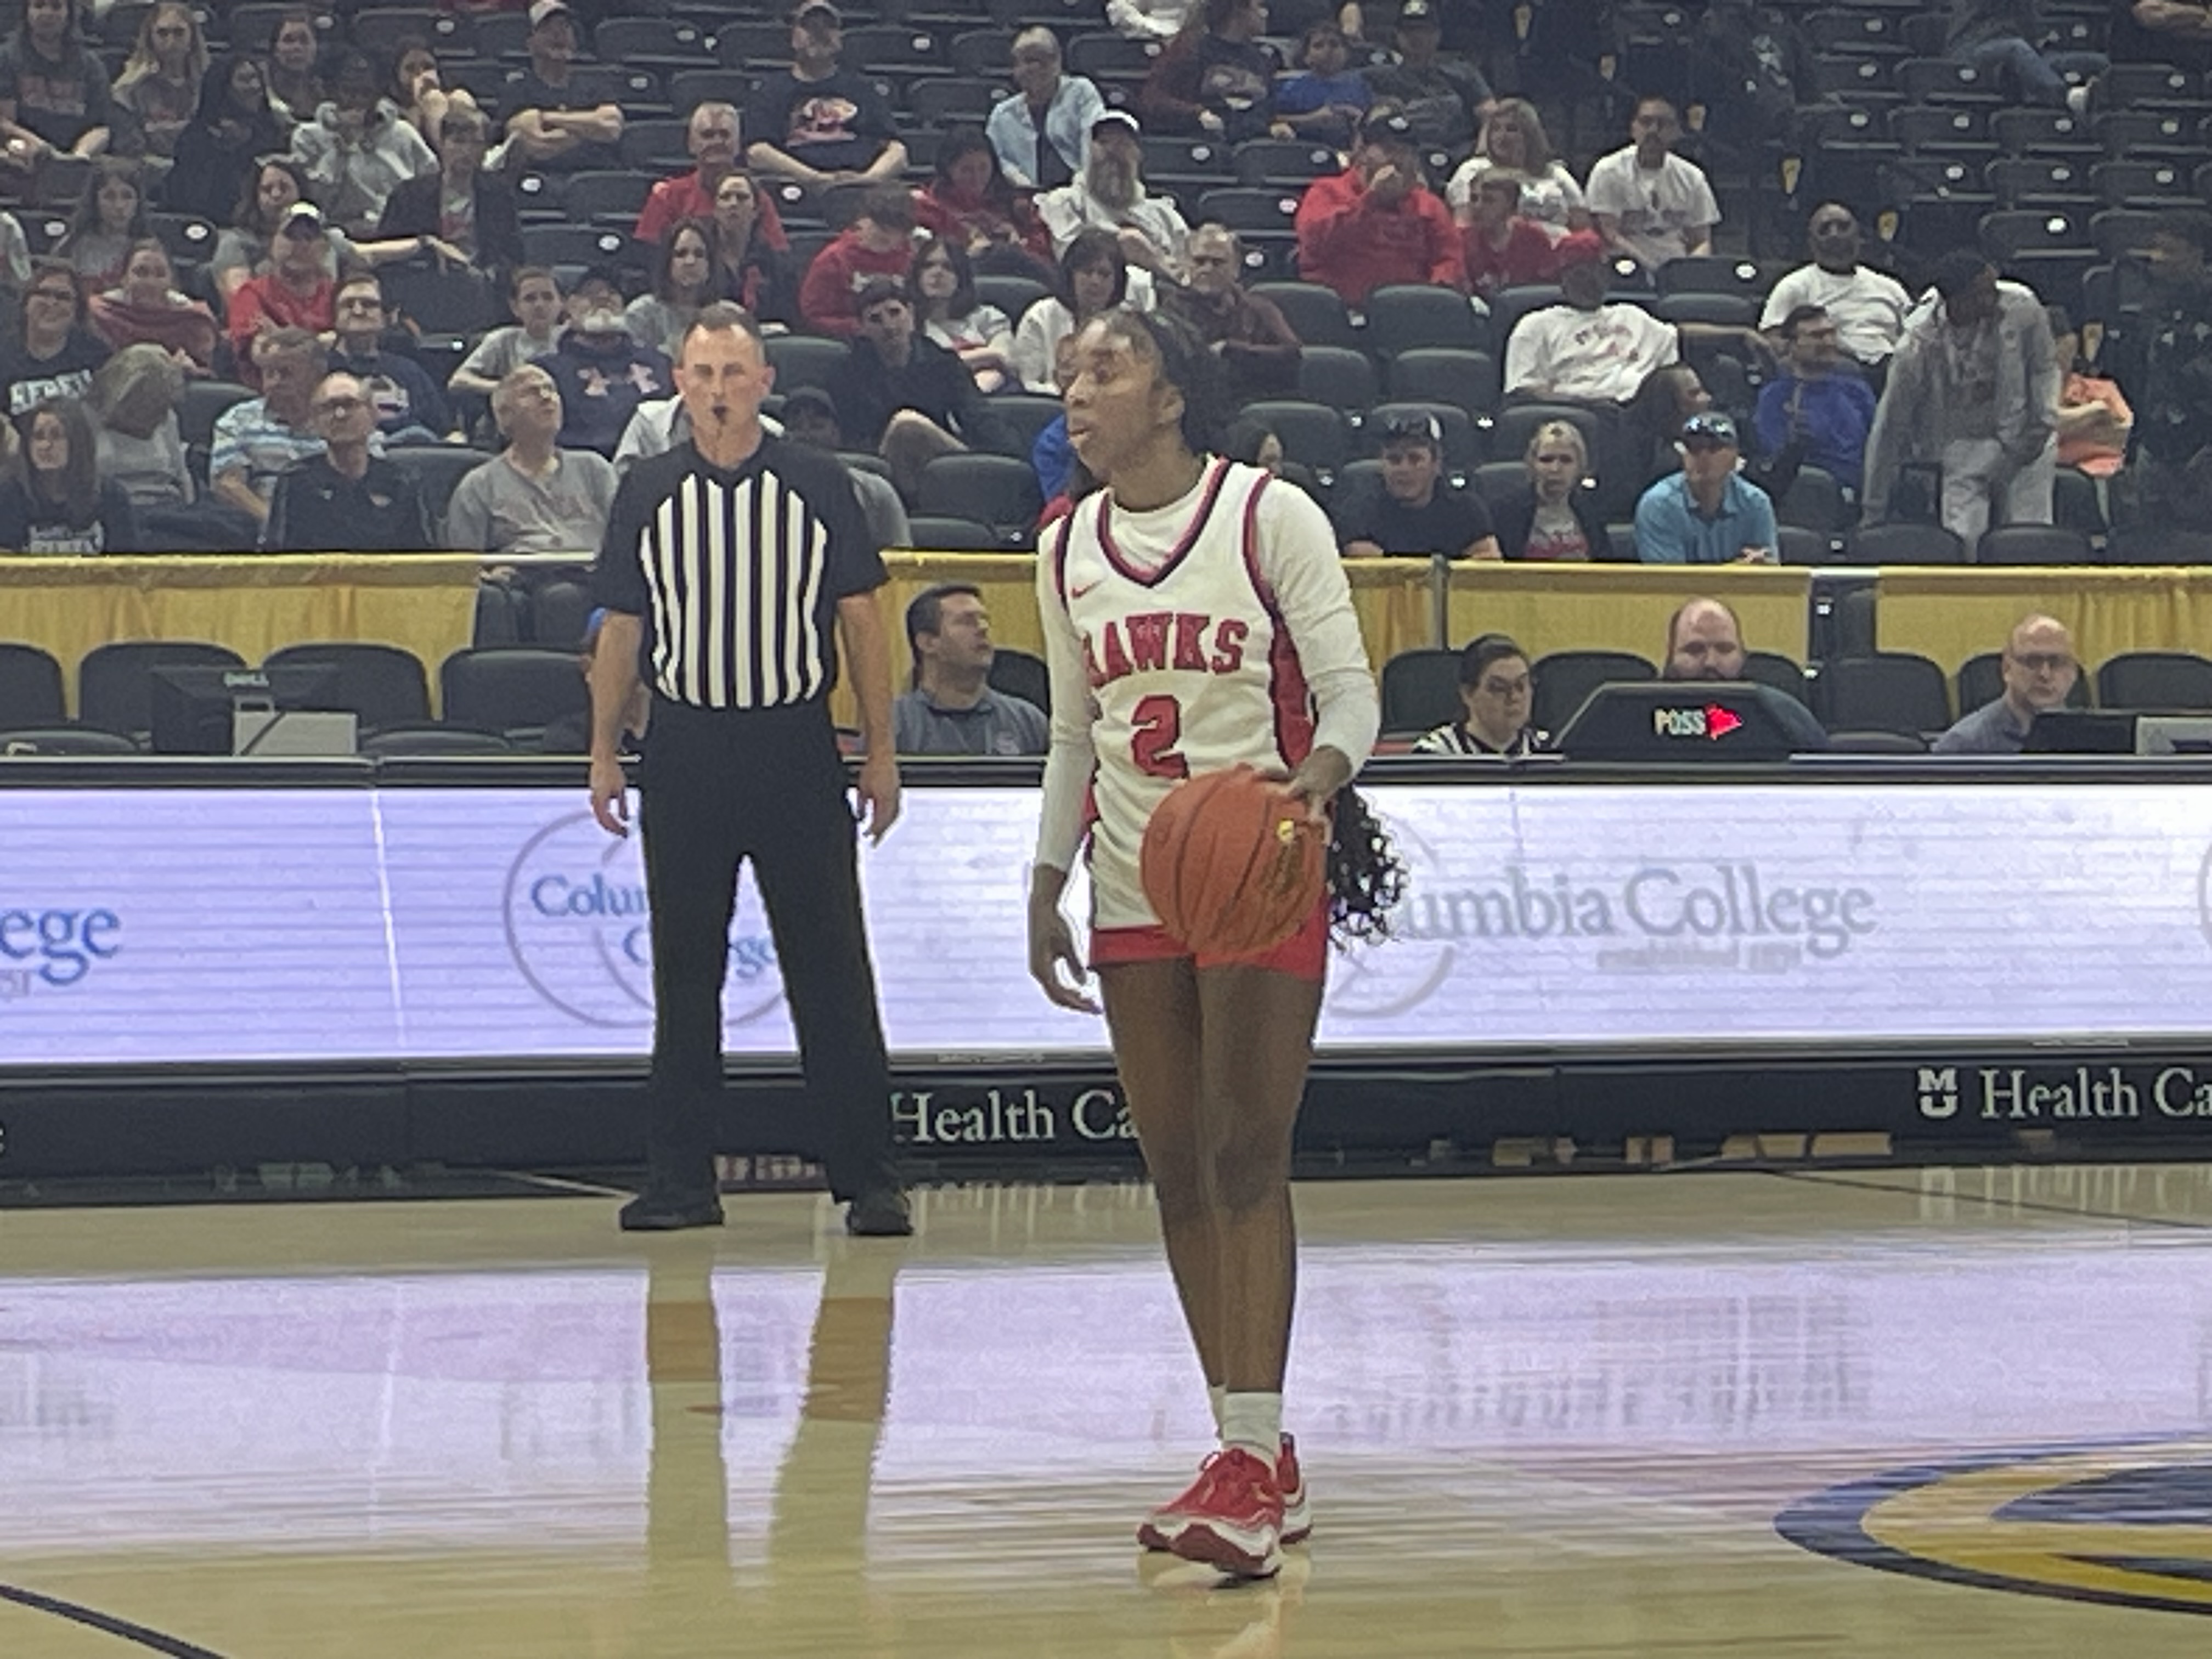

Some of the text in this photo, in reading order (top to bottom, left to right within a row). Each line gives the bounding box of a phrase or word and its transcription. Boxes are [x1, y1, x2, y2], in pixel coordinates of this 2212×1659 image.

[1131, 694, 1189, 779] 2
[1654, 708, 1705, 735] POSS
[1397, 865, 1877, 960] umbia College
[890, 1089, 1056, 1143] Health
[1979, 1066, 2140, 1119] Health
